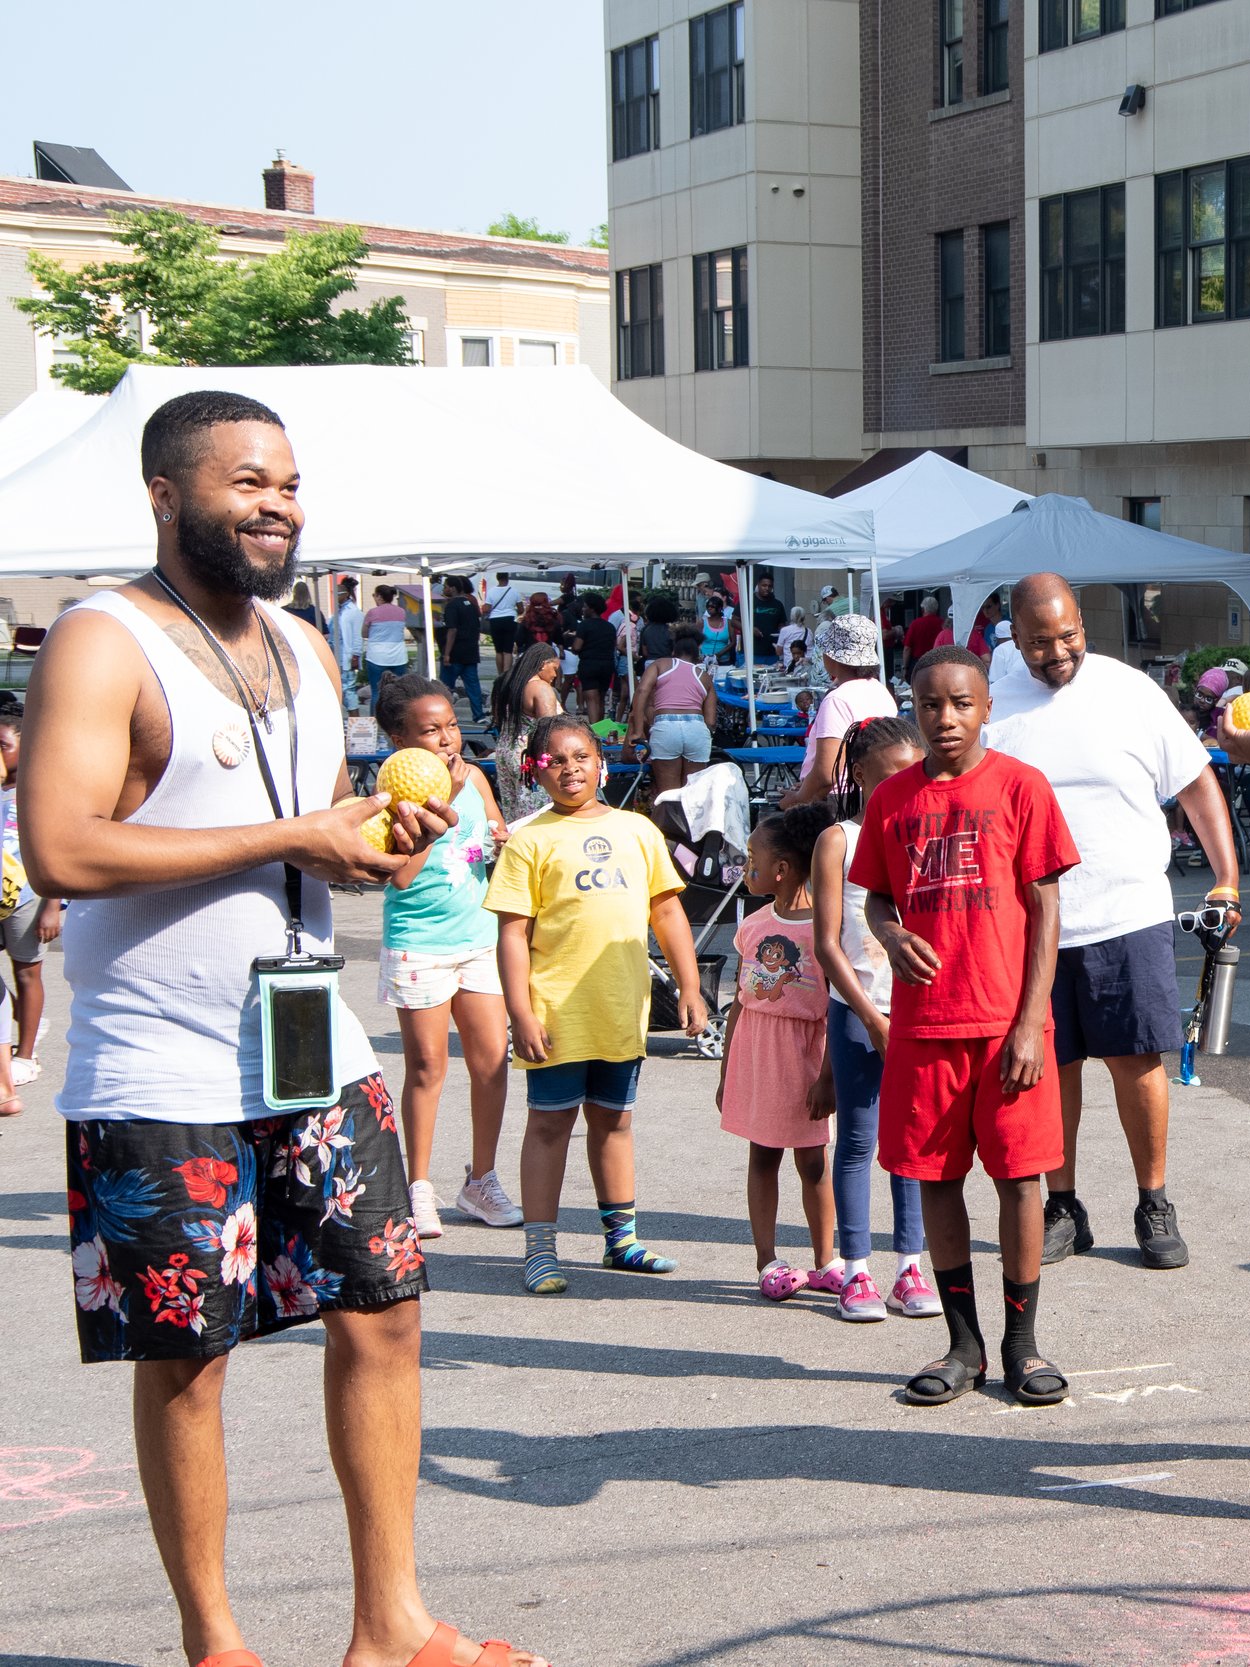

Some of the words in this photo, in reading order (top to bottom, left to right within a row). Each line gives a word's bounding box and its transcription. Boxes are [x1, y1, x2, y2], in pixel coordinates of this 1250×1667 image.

[802, 536, 846, 547] gigatent
[906, 812, 947, 841] PUT
[952, 809, 996, 834] THE
[905, 831, 980, 886] ME
[575, 868, 628, 891] COA
[905, 886, 999, 915] AWESOME!
